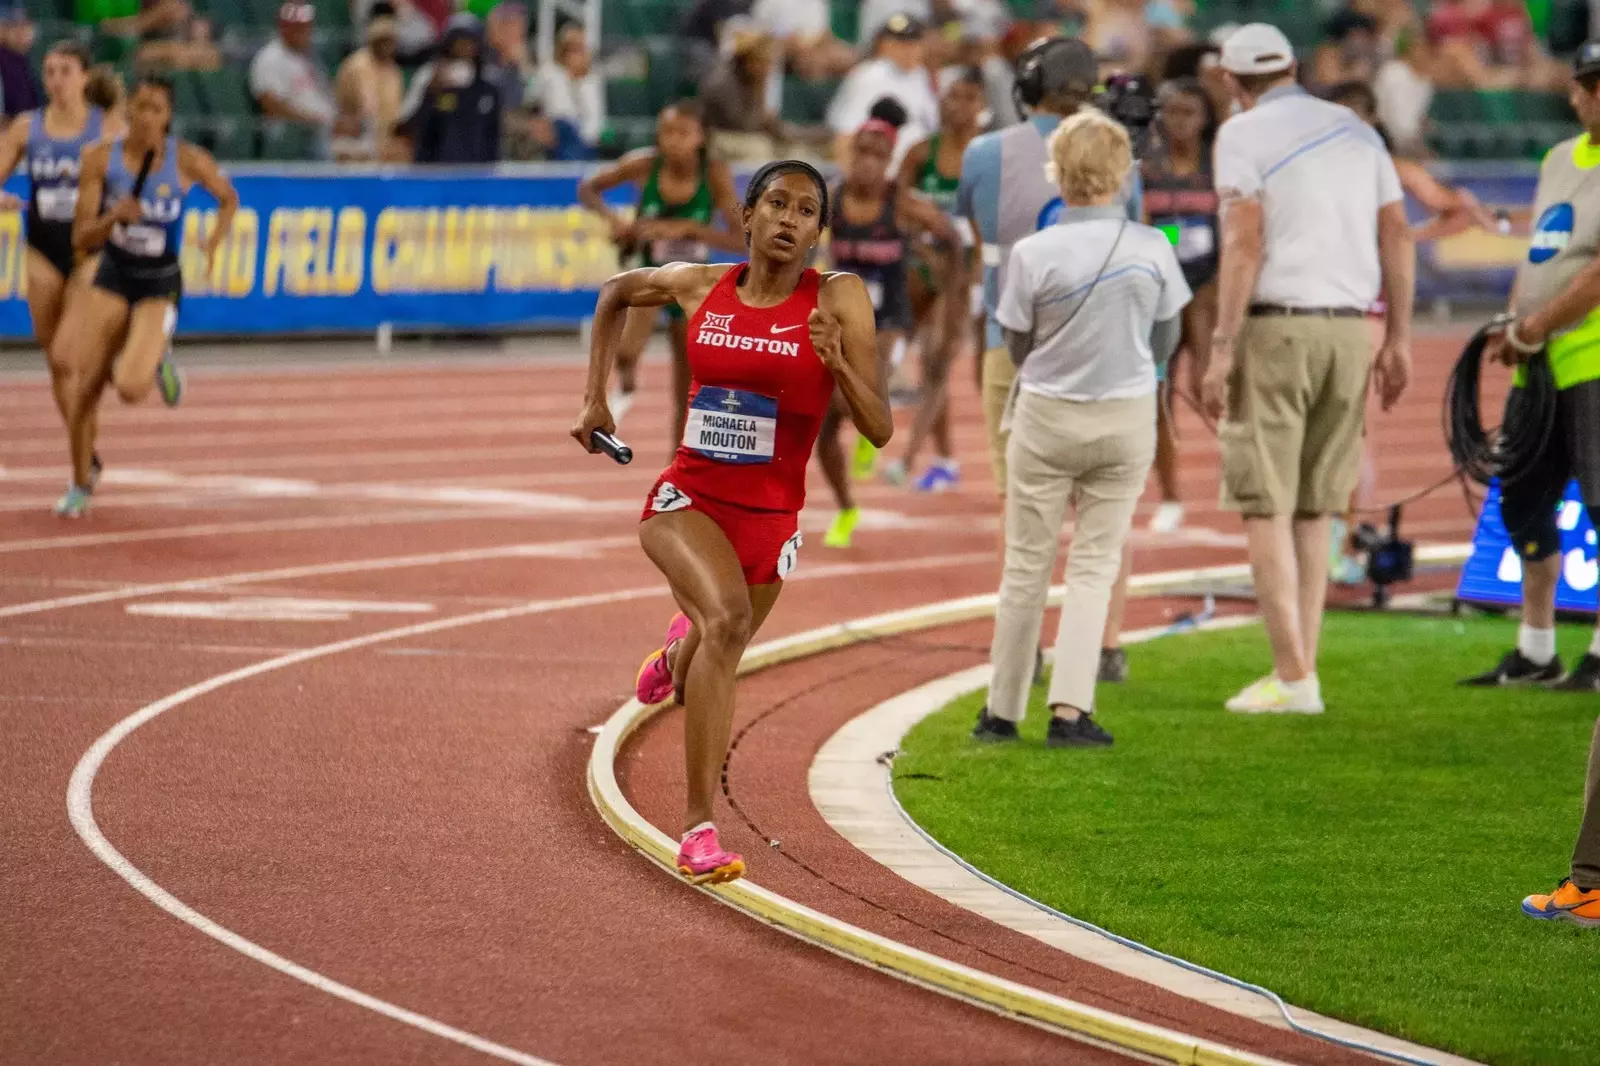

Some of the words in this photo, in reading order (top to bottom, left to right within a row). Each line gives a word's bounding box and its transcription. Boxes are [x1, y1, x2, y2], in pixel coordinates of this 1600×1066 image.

[264, 208, 366, 297] FIELD
[696, 331, 799, 357] HOUSTON
[703, 415, 756, 432] MICHAELA
[700, 430, 756, 450] MOUTON
